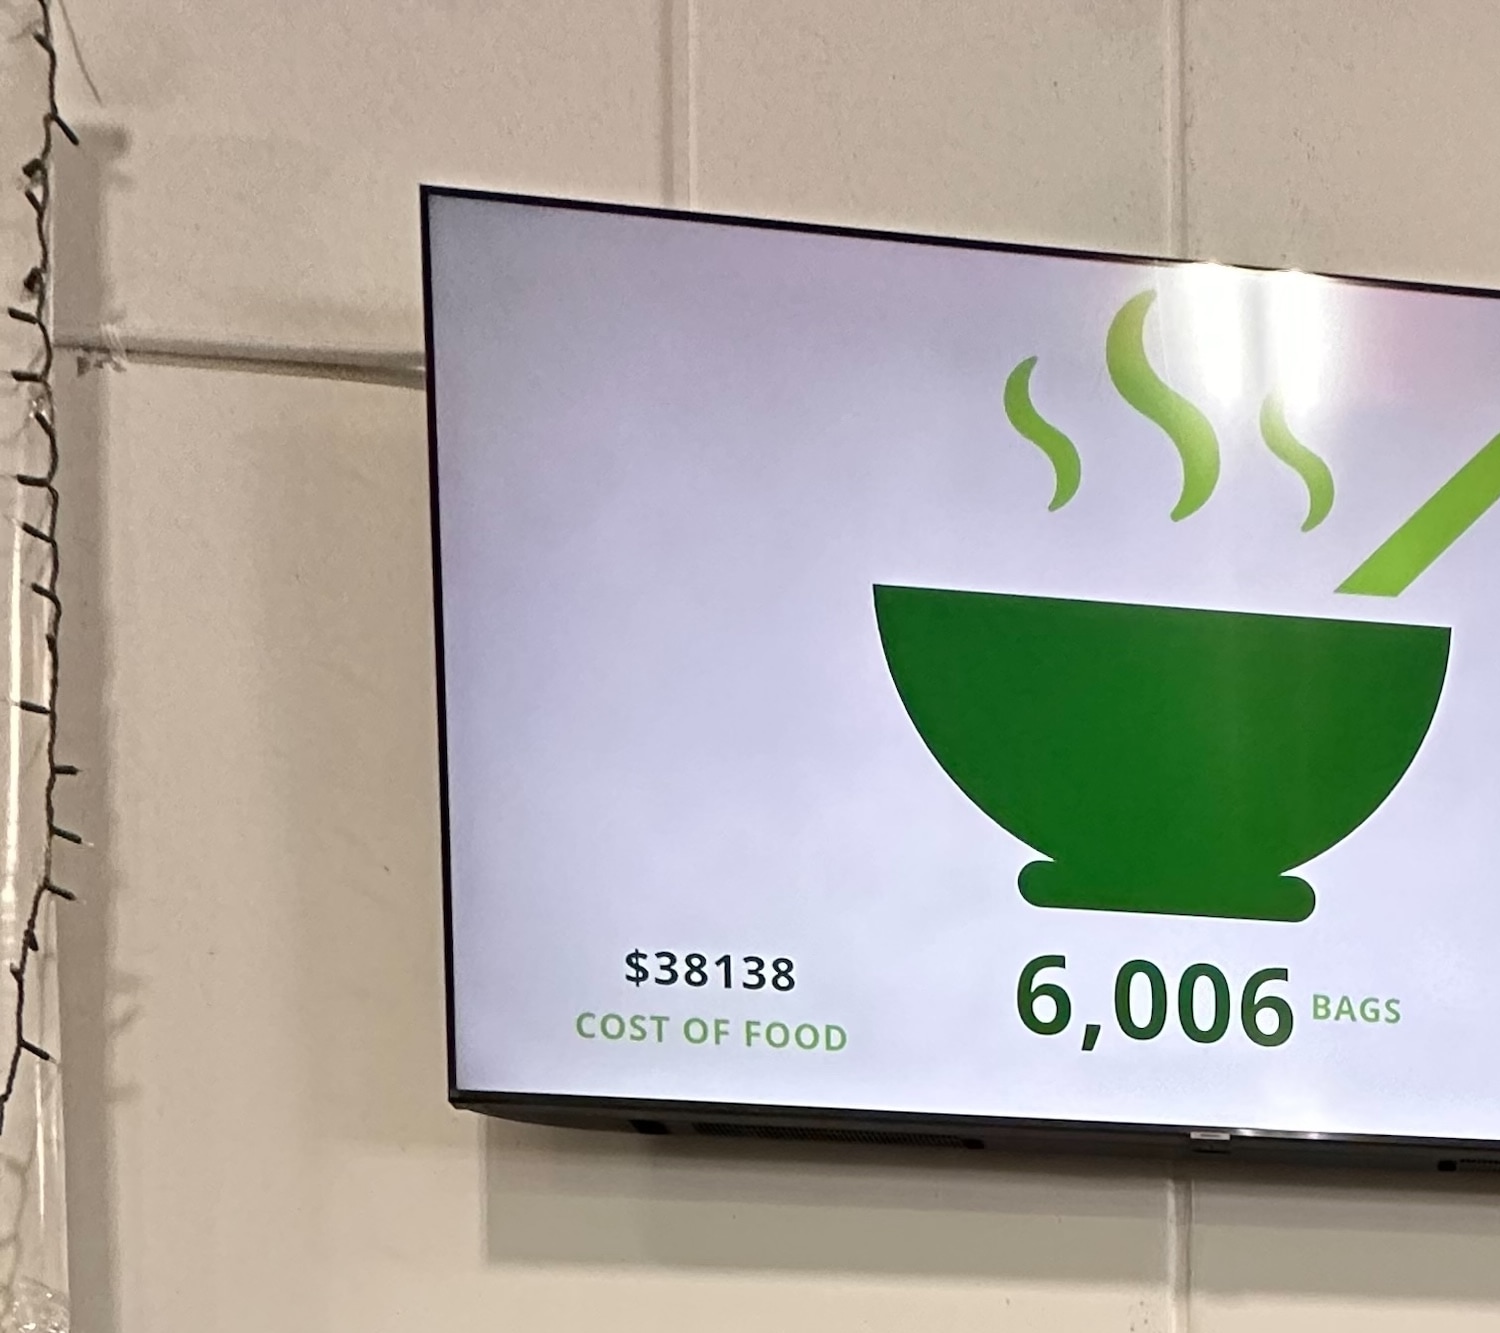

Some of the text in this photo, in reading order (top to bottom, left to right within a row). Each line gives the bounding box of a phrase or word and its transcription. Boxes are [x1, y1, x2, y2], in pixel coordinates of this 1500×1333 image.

[624, 948, 796, 992] $38138
[1016, 954, 1402, 1052] 6,006 BAGS
[575, 1012, 848, 1052] COST OF FOOD
